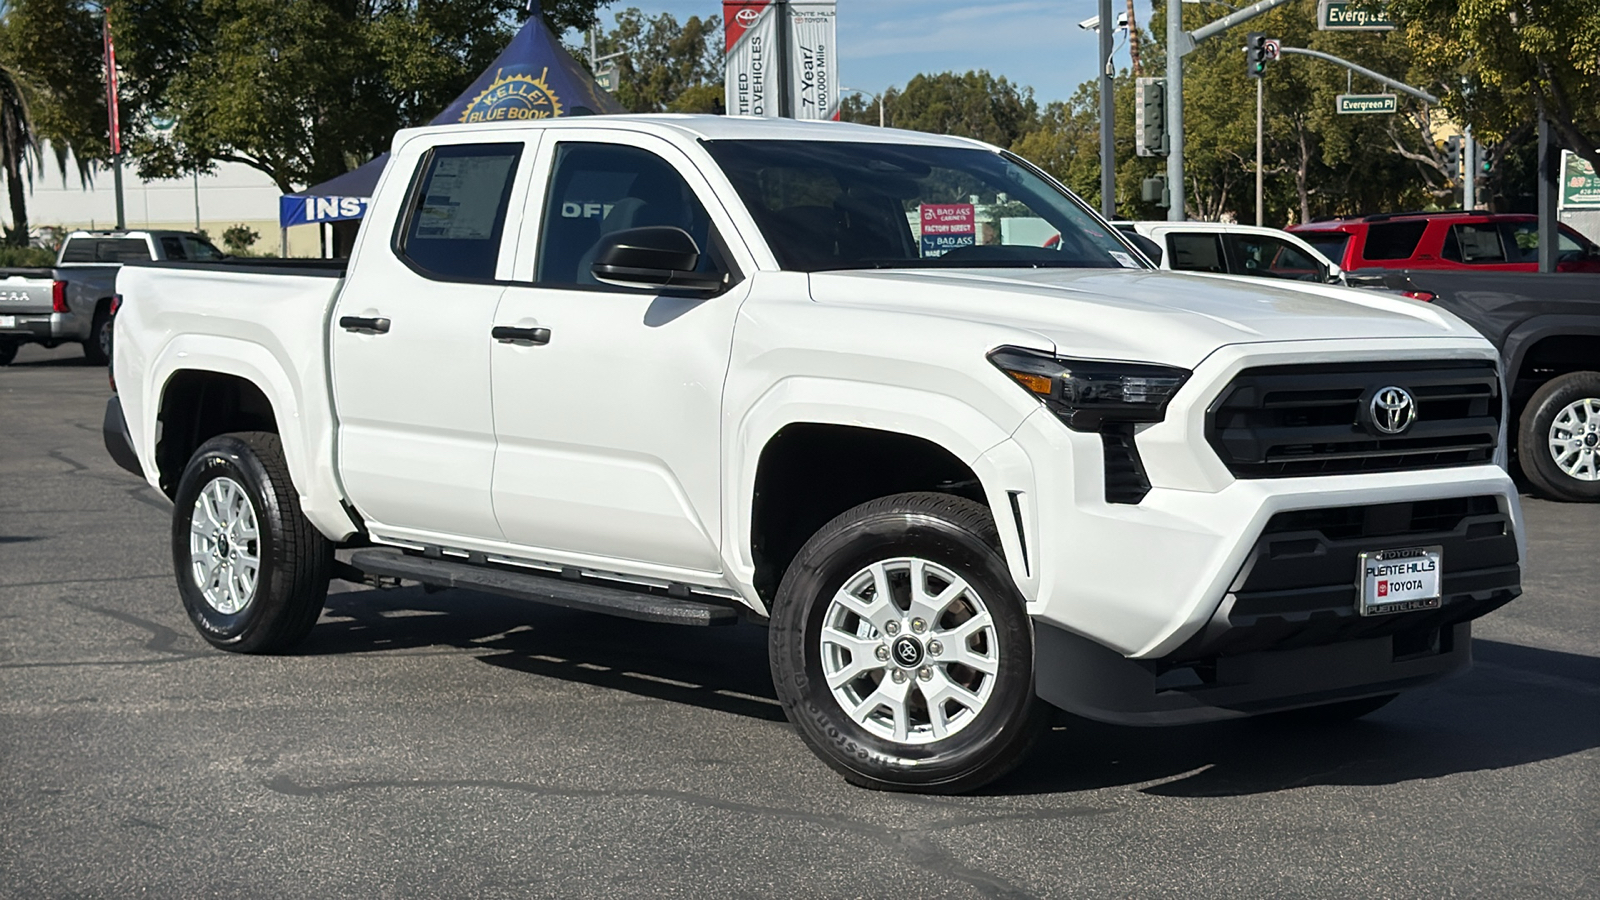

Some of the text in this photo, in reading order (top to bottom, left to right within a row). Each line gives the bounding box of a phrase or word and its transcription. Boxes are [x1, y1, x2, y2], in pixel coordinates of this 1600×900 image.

[752, 36, 763, 101] VEHICLES
[800, 46, 815, 107] 7 Year/
[816, 44, 827, 111] 100,000 Mile
[482, 83, 549, 106] KELLEY
[1343, 100, 1383, 111] Evergreen
[469, 107, 550, 123] BLUE BOOK
[936, 208, 971, 216] BAD ASS
[936, 236, 973, 245] BAD ASS
[1384, 548, 1423, 559] TOYOTA
[1366, 561, 1435, 578] PUENTE HILLS
[1389, 580, 1423, 592] TOYOTA
